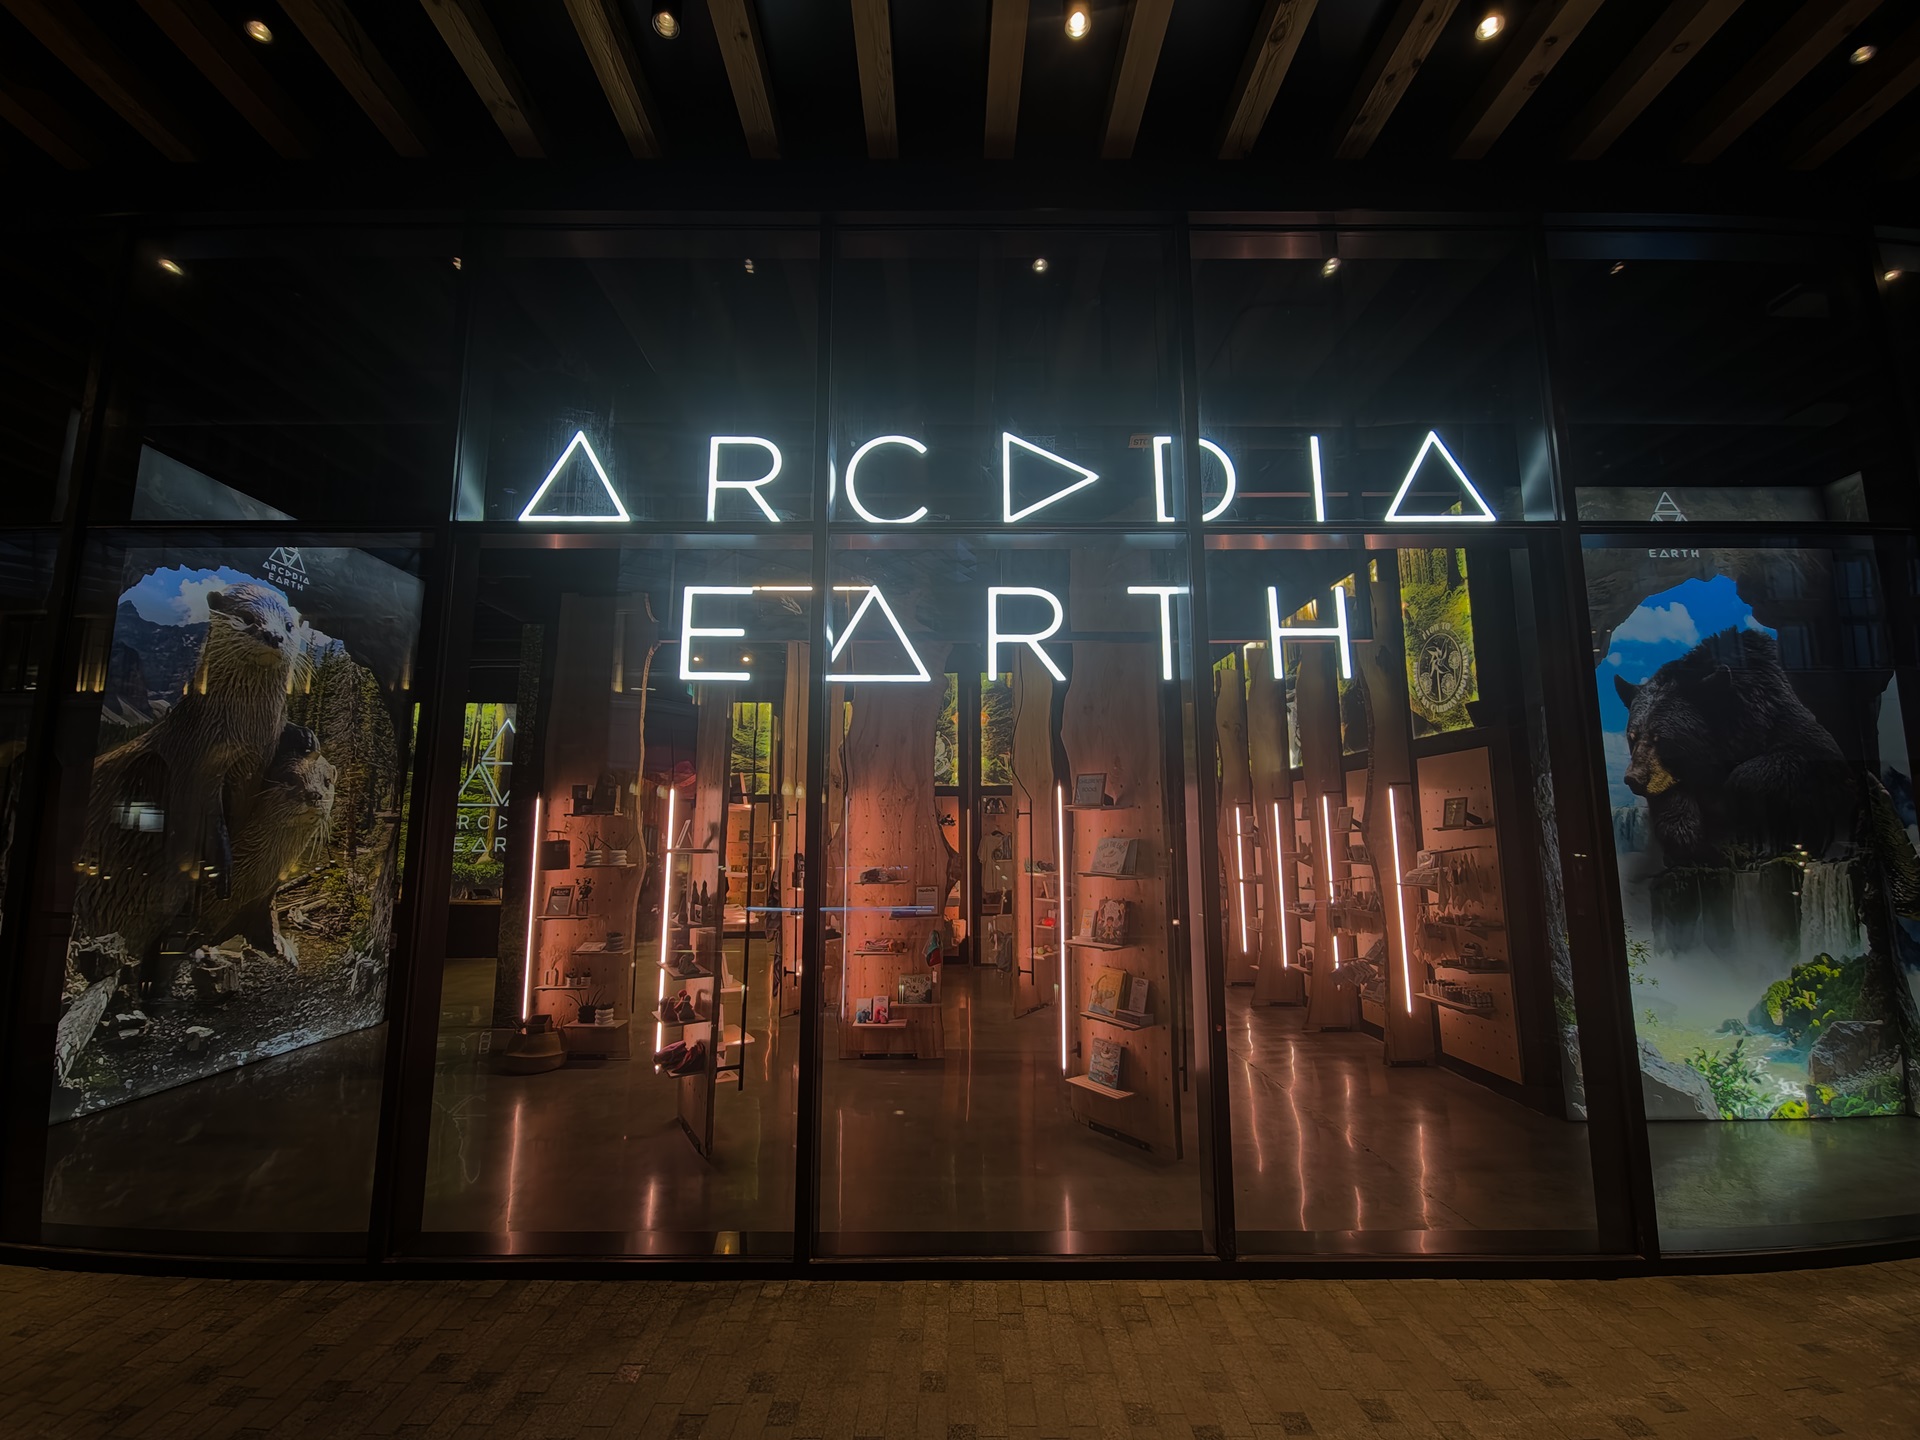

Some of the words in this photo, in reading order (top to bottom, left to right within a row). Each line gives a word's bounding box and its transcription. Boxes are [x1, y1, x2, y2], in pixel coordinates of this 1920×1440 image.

[517, 430, 1497, 524] ARCADIA
[1648, 548, 1700, 558] EARTH
[262, 561, 310, 585] ARCADIA
[268, 572, 304, 591] EARTH
[679, 584, 1353, 682] EARTH
